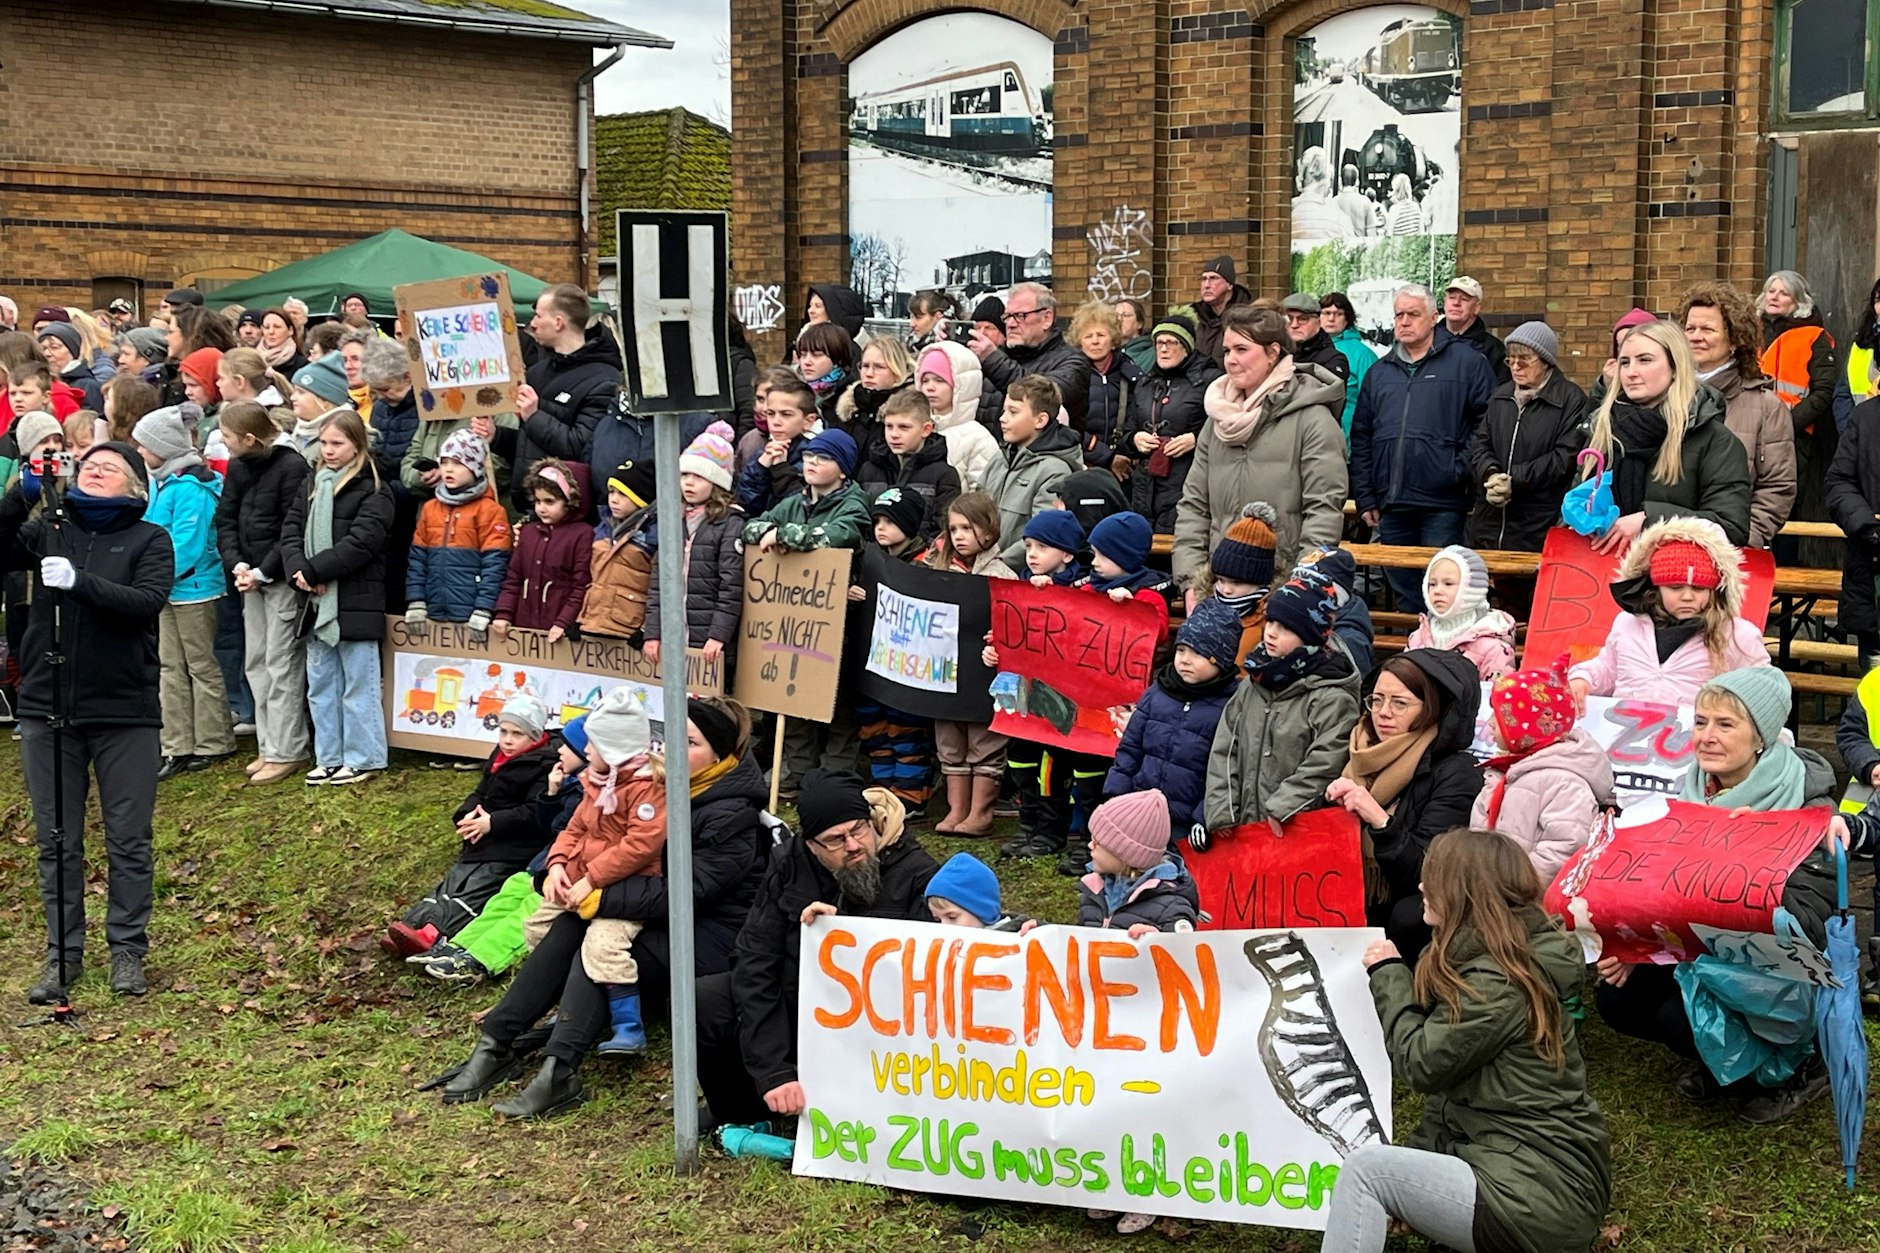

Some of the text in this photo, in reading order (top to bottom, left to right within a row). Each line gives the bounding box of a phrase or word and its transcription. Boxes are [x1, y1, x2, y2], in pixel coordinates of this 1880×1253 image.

[632, 224, 720, 399] H
[426, 354, 505, 384] WEGKOMMEN
[431, 341, 458, 359] KEIN
[747, 558, 836, 611] Schneidet
[747, 616, 830, 652] uns NICHT
[877, 590, 947, 639] SCHIENE
[996, 599, 1149, 688] DER ZUG
[1640, 816, 1829, 865] DENKT AN
[1594, 850, 1789, 911] DIE KINDER
[813, 929, 1221, 1057] SCHIENEN
[871, 1043, 1096, 1108] verbinden
[808, 1107, 877, 1164] Der
[886, 1115, 986, 1180] ZUG
[993, 1139, 1112, 1193] muss
